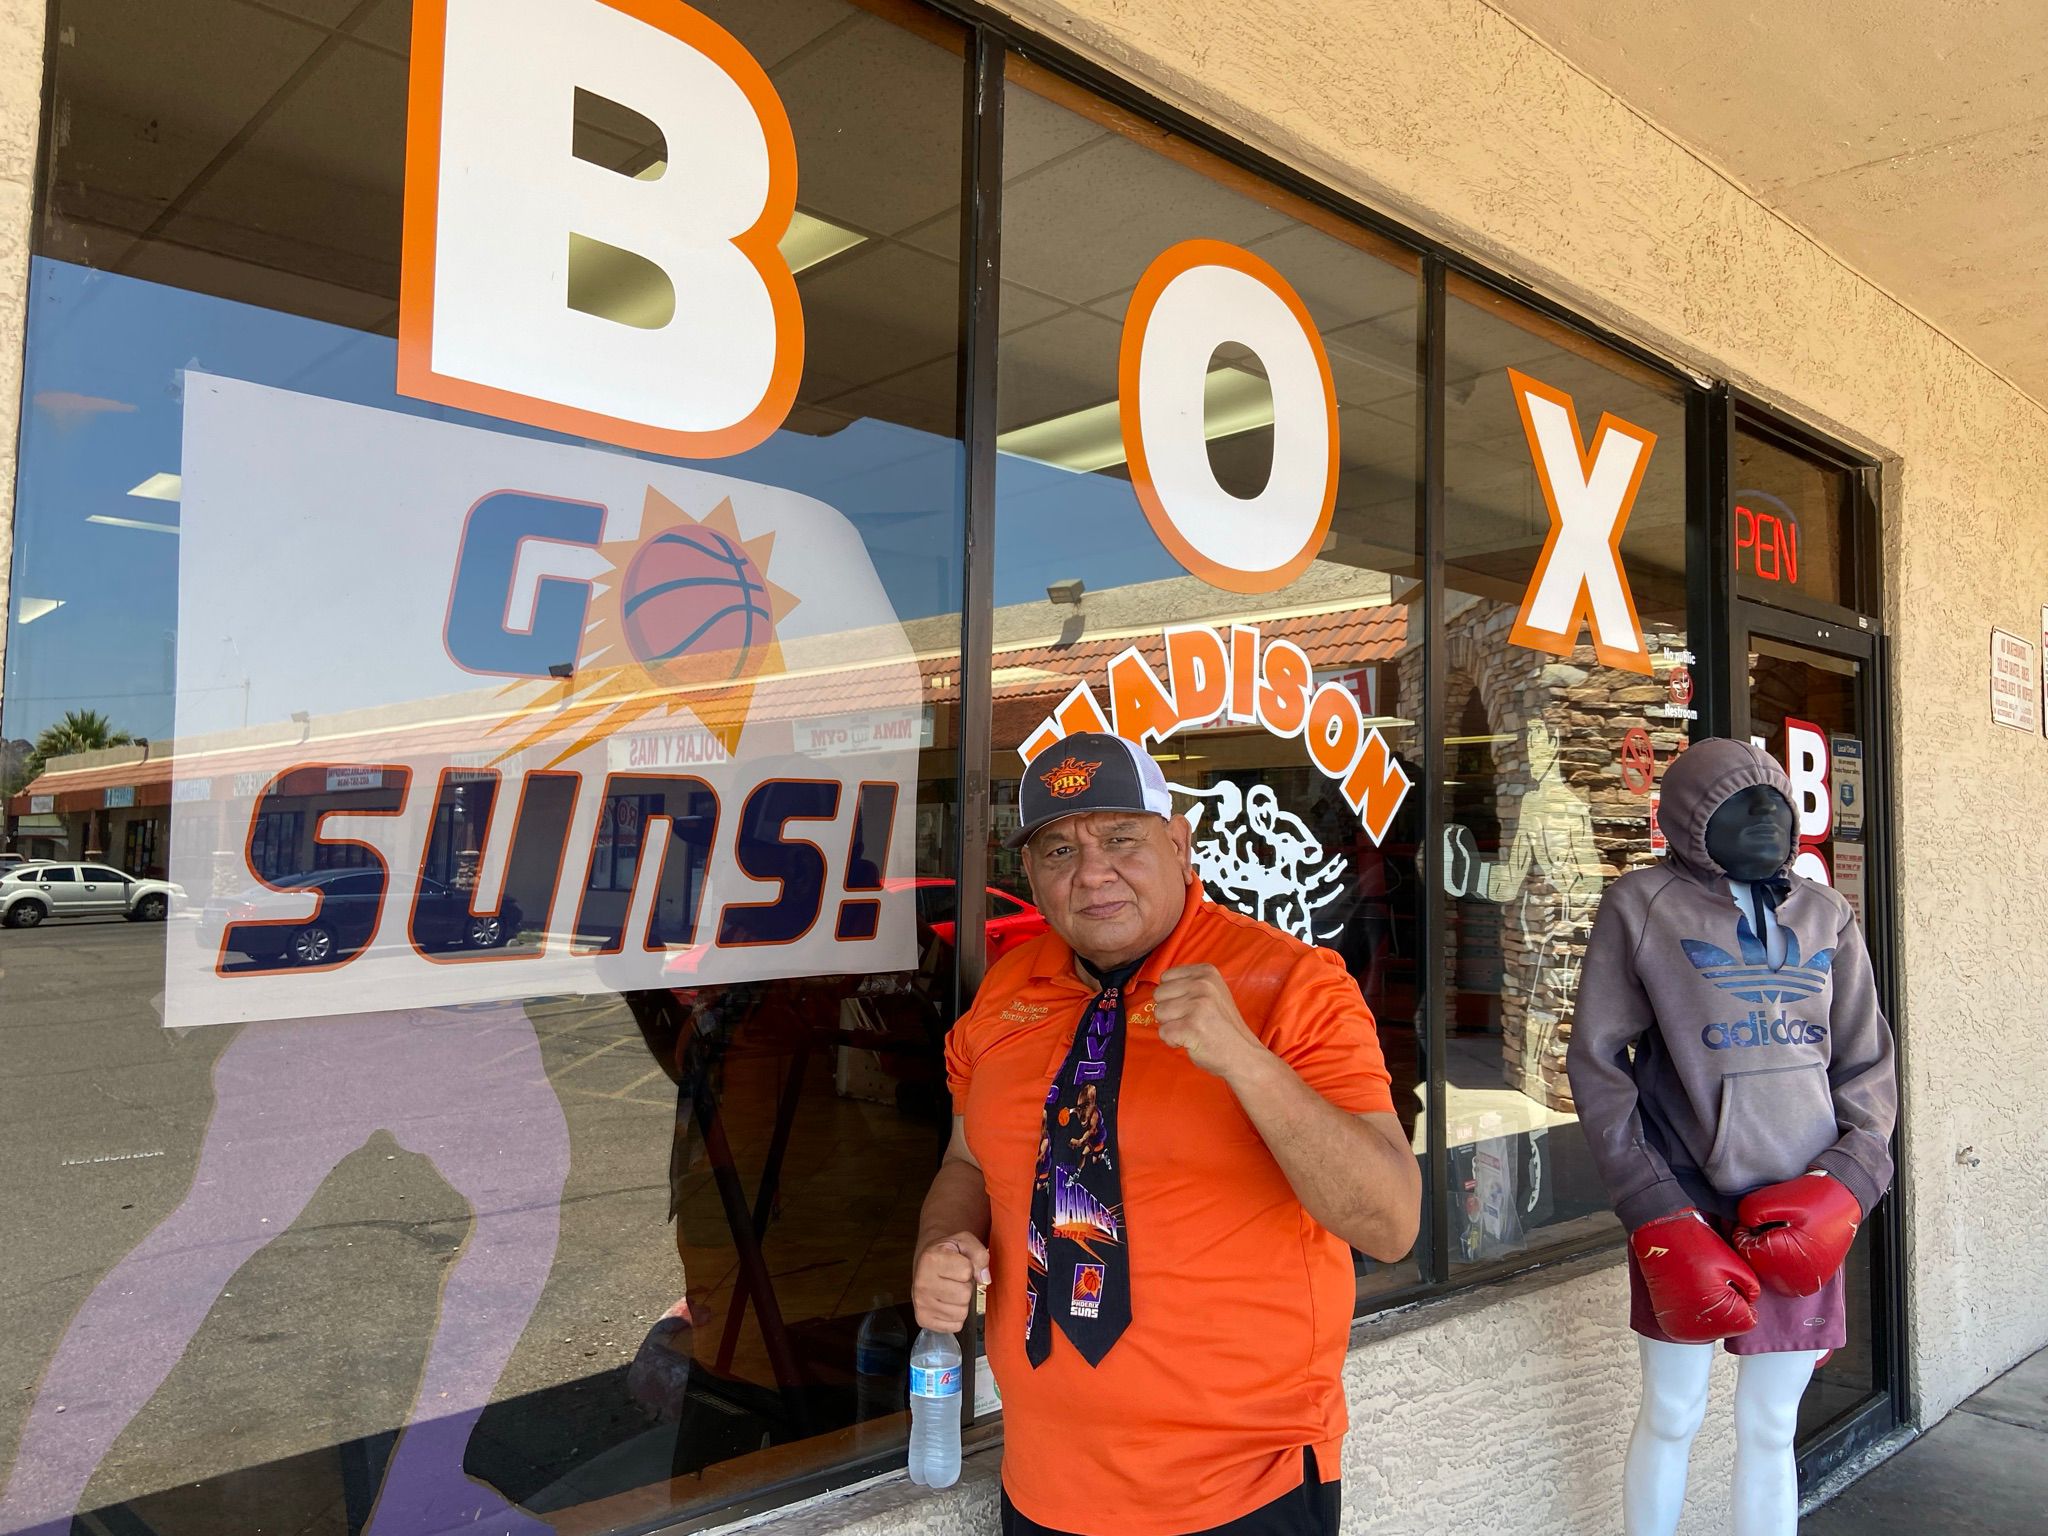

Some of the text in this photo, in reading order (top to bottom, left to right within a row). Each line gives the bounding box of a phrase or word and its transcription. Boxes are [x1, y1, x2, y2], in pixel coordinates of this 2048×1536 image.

[1664, 703, 1698, 720] Restroom
[1053, 775, 1087, 792] PHX
[215, 762, 899, 978] SUNS!
[1701, 1010, 1828, 1050] adidas
[1069, 1306, 1099, 1319] SUNS
